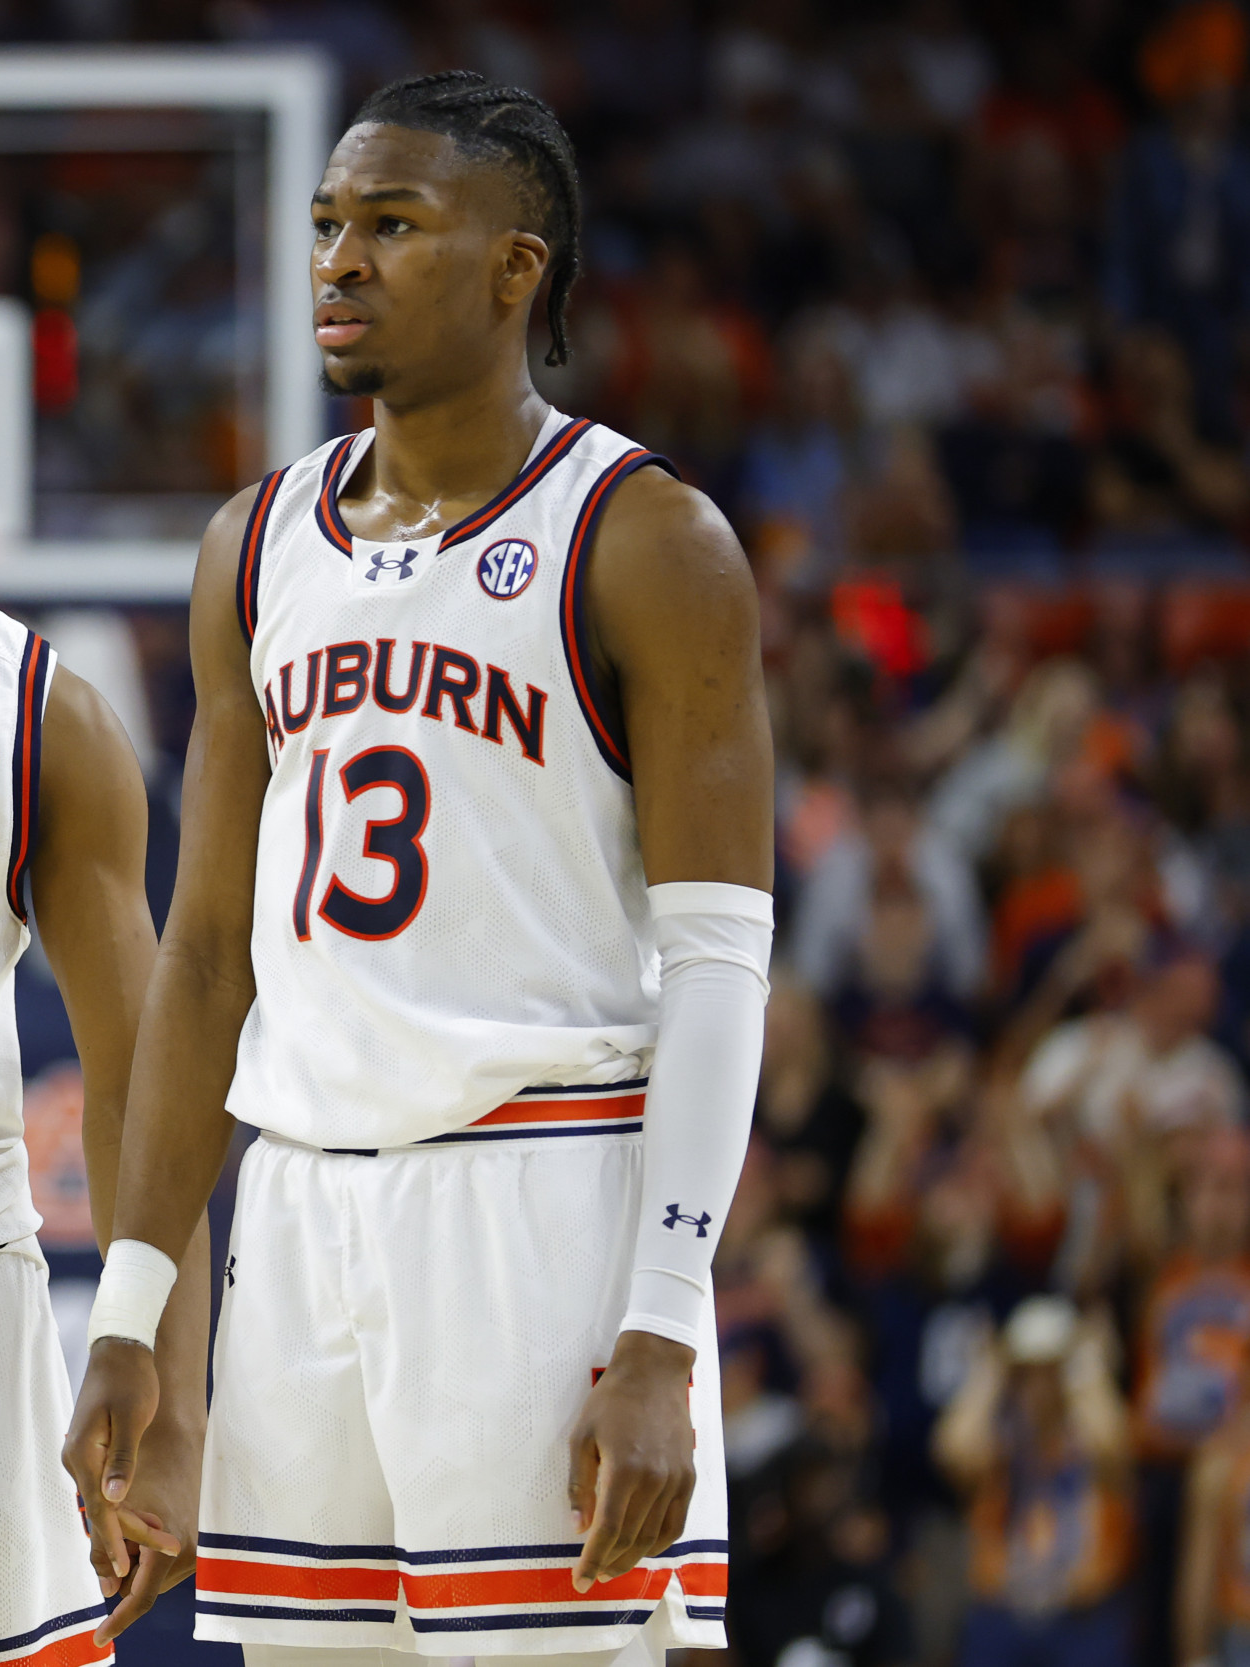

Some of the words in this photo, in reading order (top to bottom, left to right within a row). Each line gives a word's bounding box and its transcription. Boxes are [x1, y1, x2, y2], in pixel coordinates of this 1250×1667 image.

[480, 541, 534, 595] SEC
[264, 638, 548, 768] AUBURN
[292, 744, 432, 943] 13
